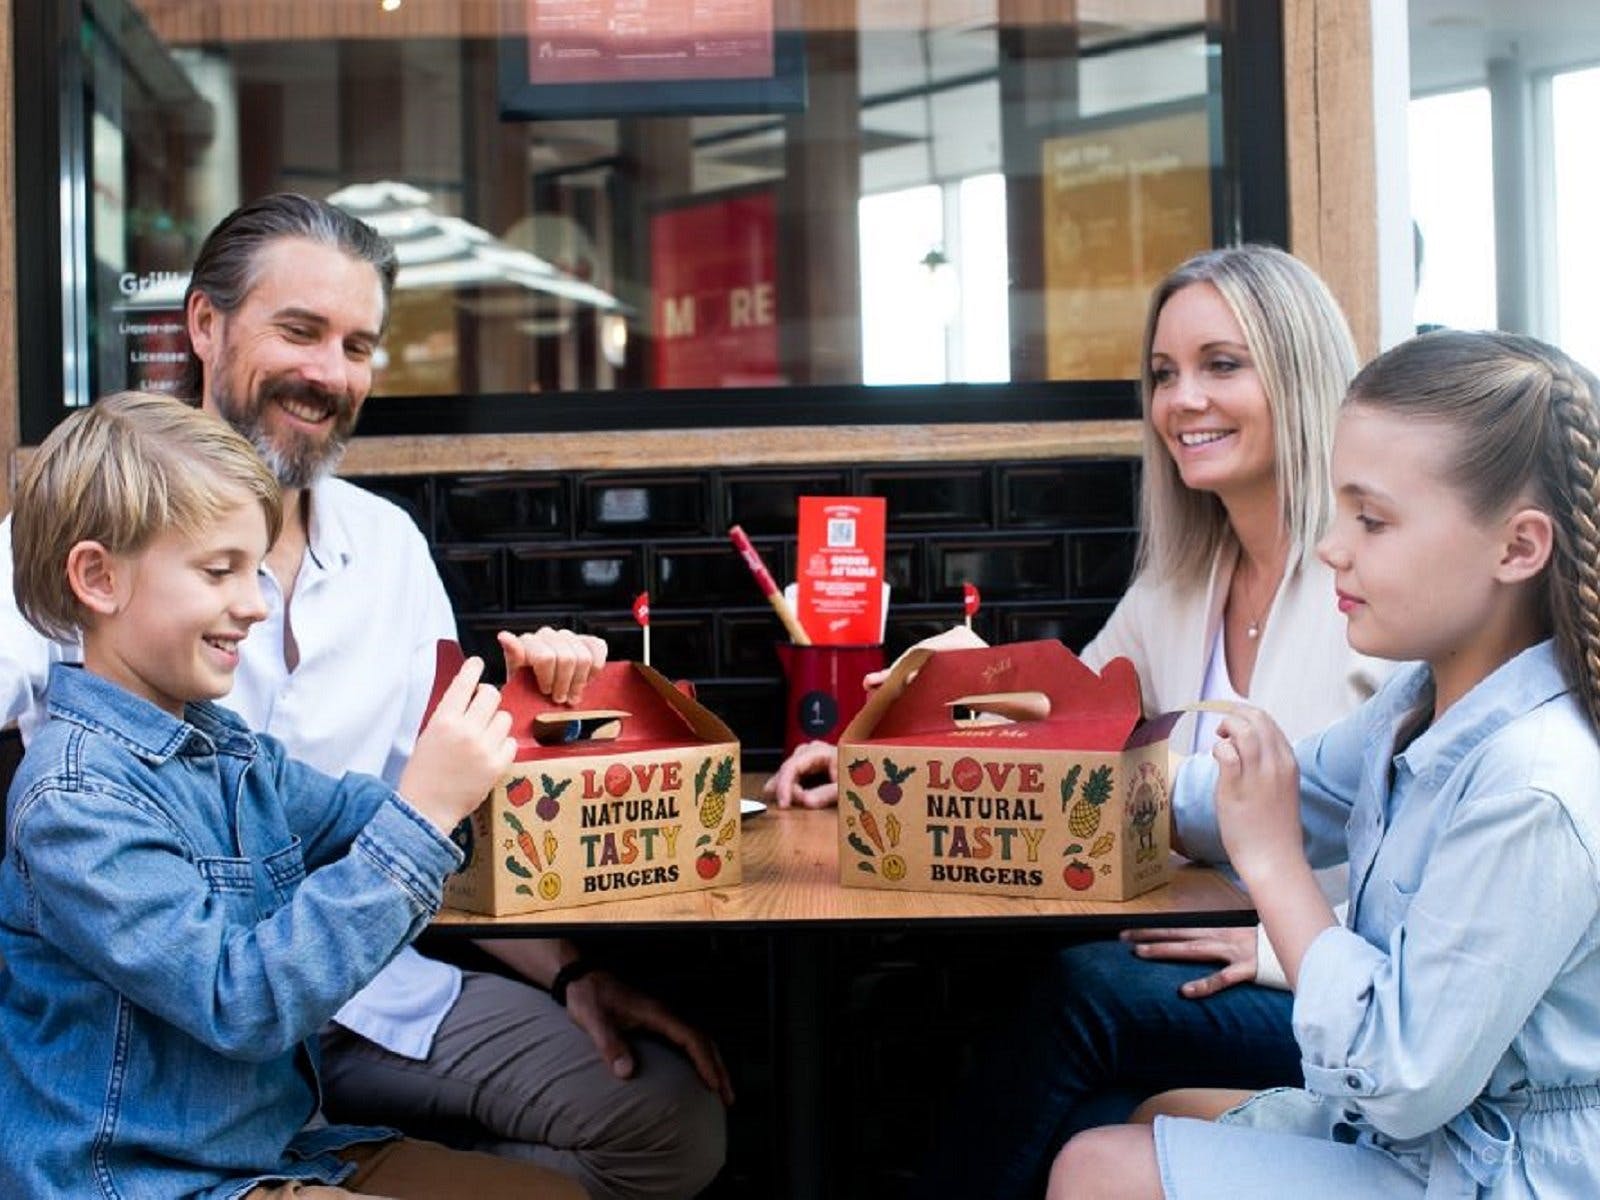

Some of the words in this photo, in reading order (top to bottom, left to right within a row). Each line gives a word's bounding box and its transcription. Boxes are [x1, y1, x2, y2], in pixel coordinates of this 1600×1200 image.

[664, 283, 774, 338] MRE
[580, 760, 683, 800] LOVE
[926, 756, 1045, 794] LOVE
[581, 796, 680, 829] NATURAL
[926, 795, 1044, 821] NATURAL
[580, 824, 682, 868] TASTY
[926, 825, 1046, 862] TASTY
[583, 864, 680, 894] BURGERS
[930, 864, 1043, 887] BURGERS
